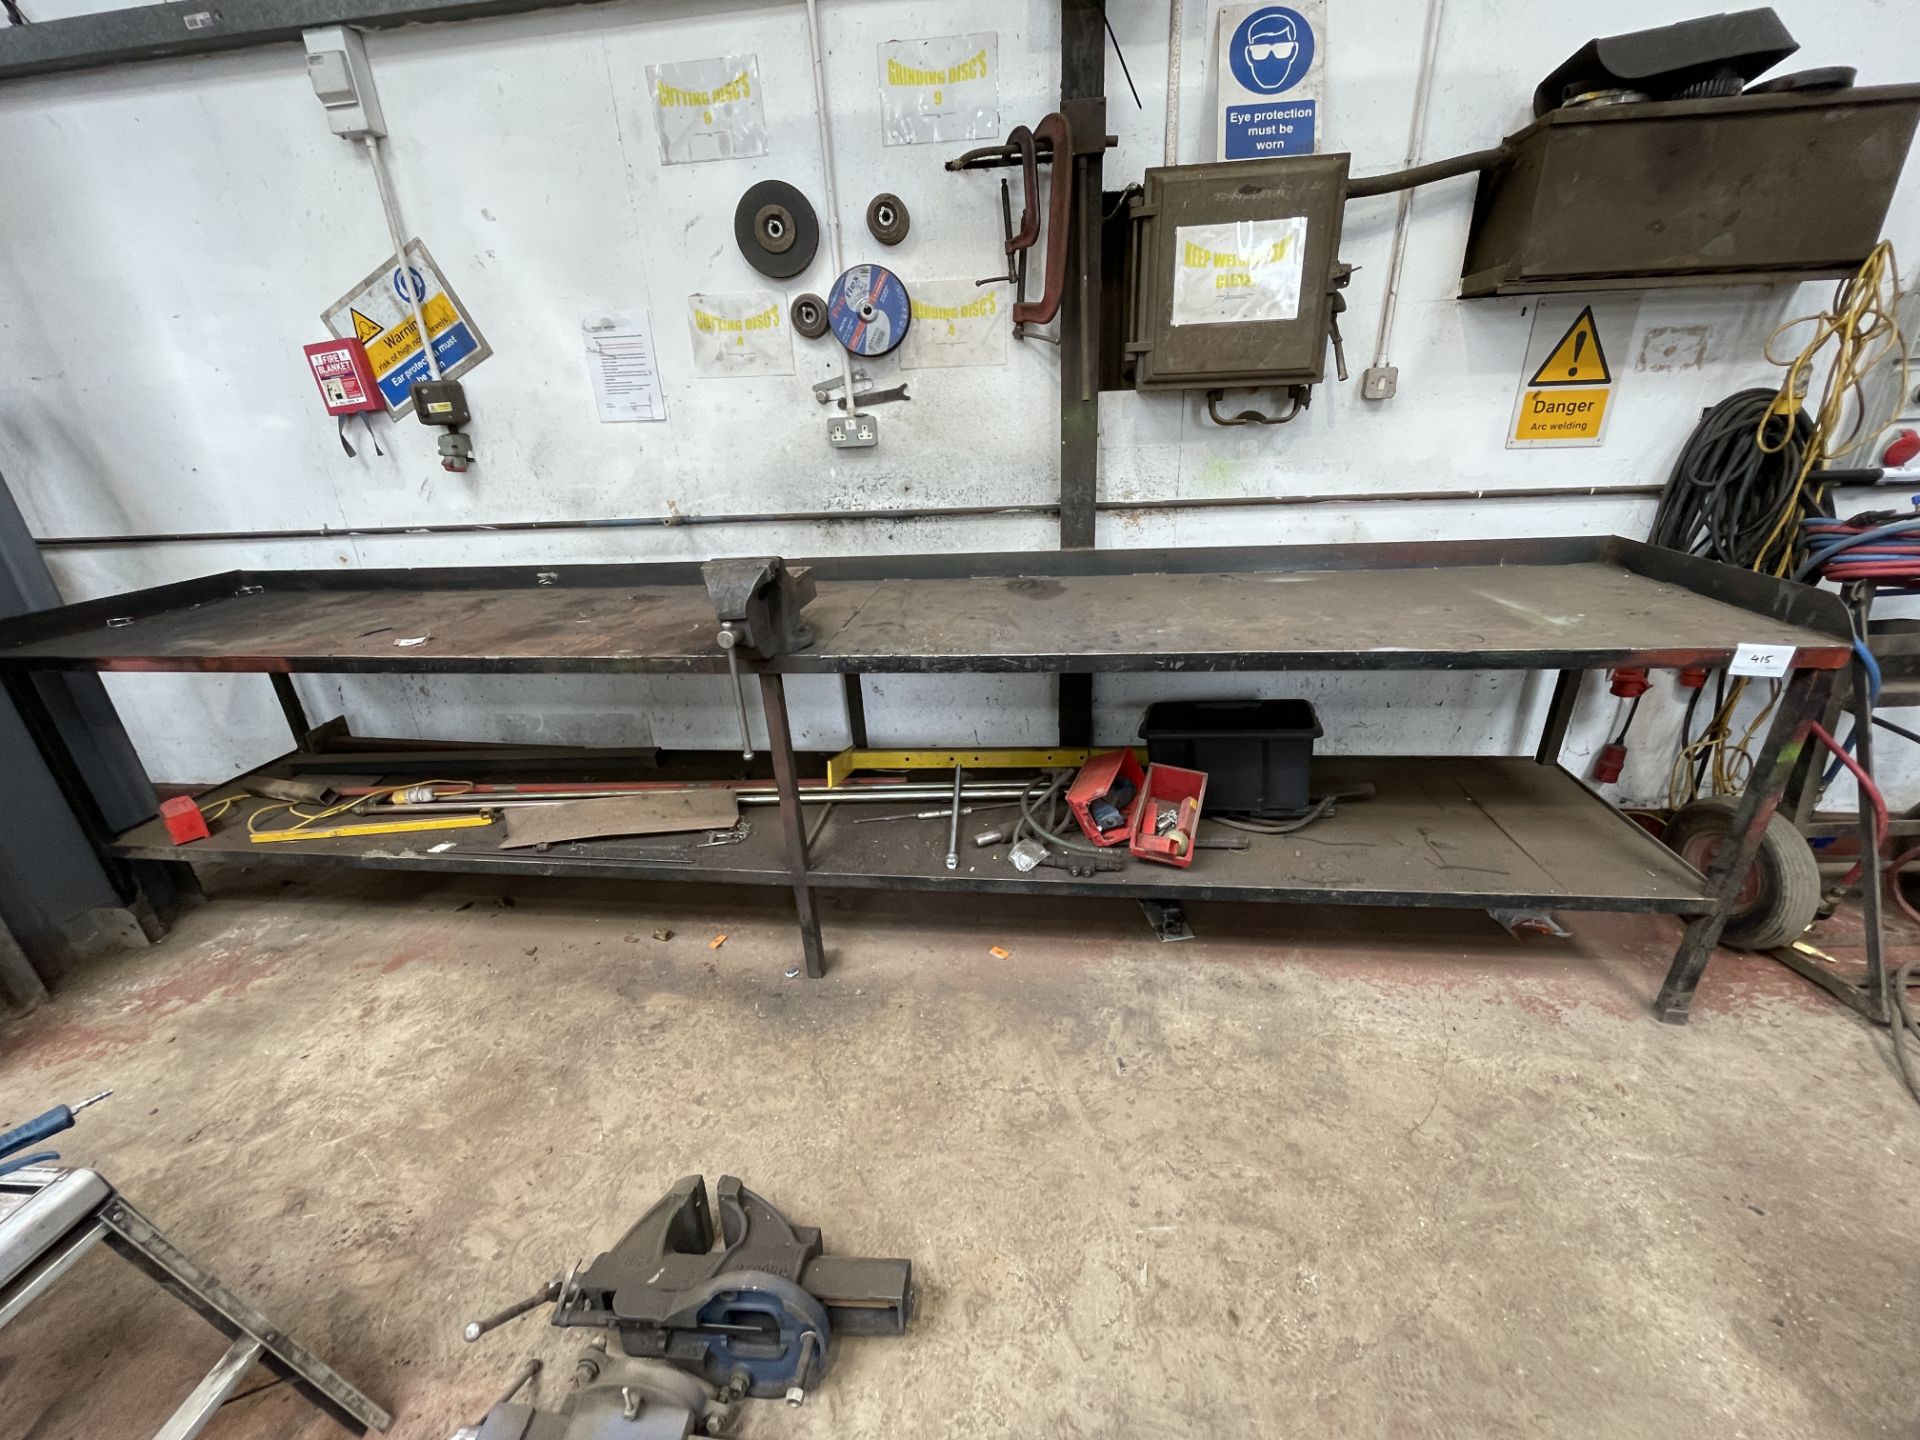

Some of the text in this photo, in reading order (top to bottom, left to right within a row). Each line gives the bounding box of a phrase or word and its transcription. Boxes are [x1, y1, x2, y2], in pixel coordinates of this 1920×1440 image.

[887, 50, 987, 86] GRINDING DISC'S
[657, 80, 710, 107] CUTTING
[1230, 108, 1312, 125] Eye protection
[1248, 124, 1294, 136] must be
[1256, 140, 1285, 150] worn
[1184, 240, 1212, 268] KEEP
[960, 289, 996, 318] DISC'S
[694, 303, 780, 333] CUTTING DISC'S
[383, 319, 426, 349] Warnin
[317, 360, 352, 374] BLANKET
[321, 353, 340, 364] FIRE
[379, 359, 391, 371] risk
[391, 353, 399, 362] of
[398, 343, 412, 357] high
[391, 375, 405, 388] Ear
[438, 335, 458, 353] must
[1533, 400, 1596, 416] Danger
[1530, 422, 1588, 432] Arc welding
[1750, 654, 1775, 664] 415
